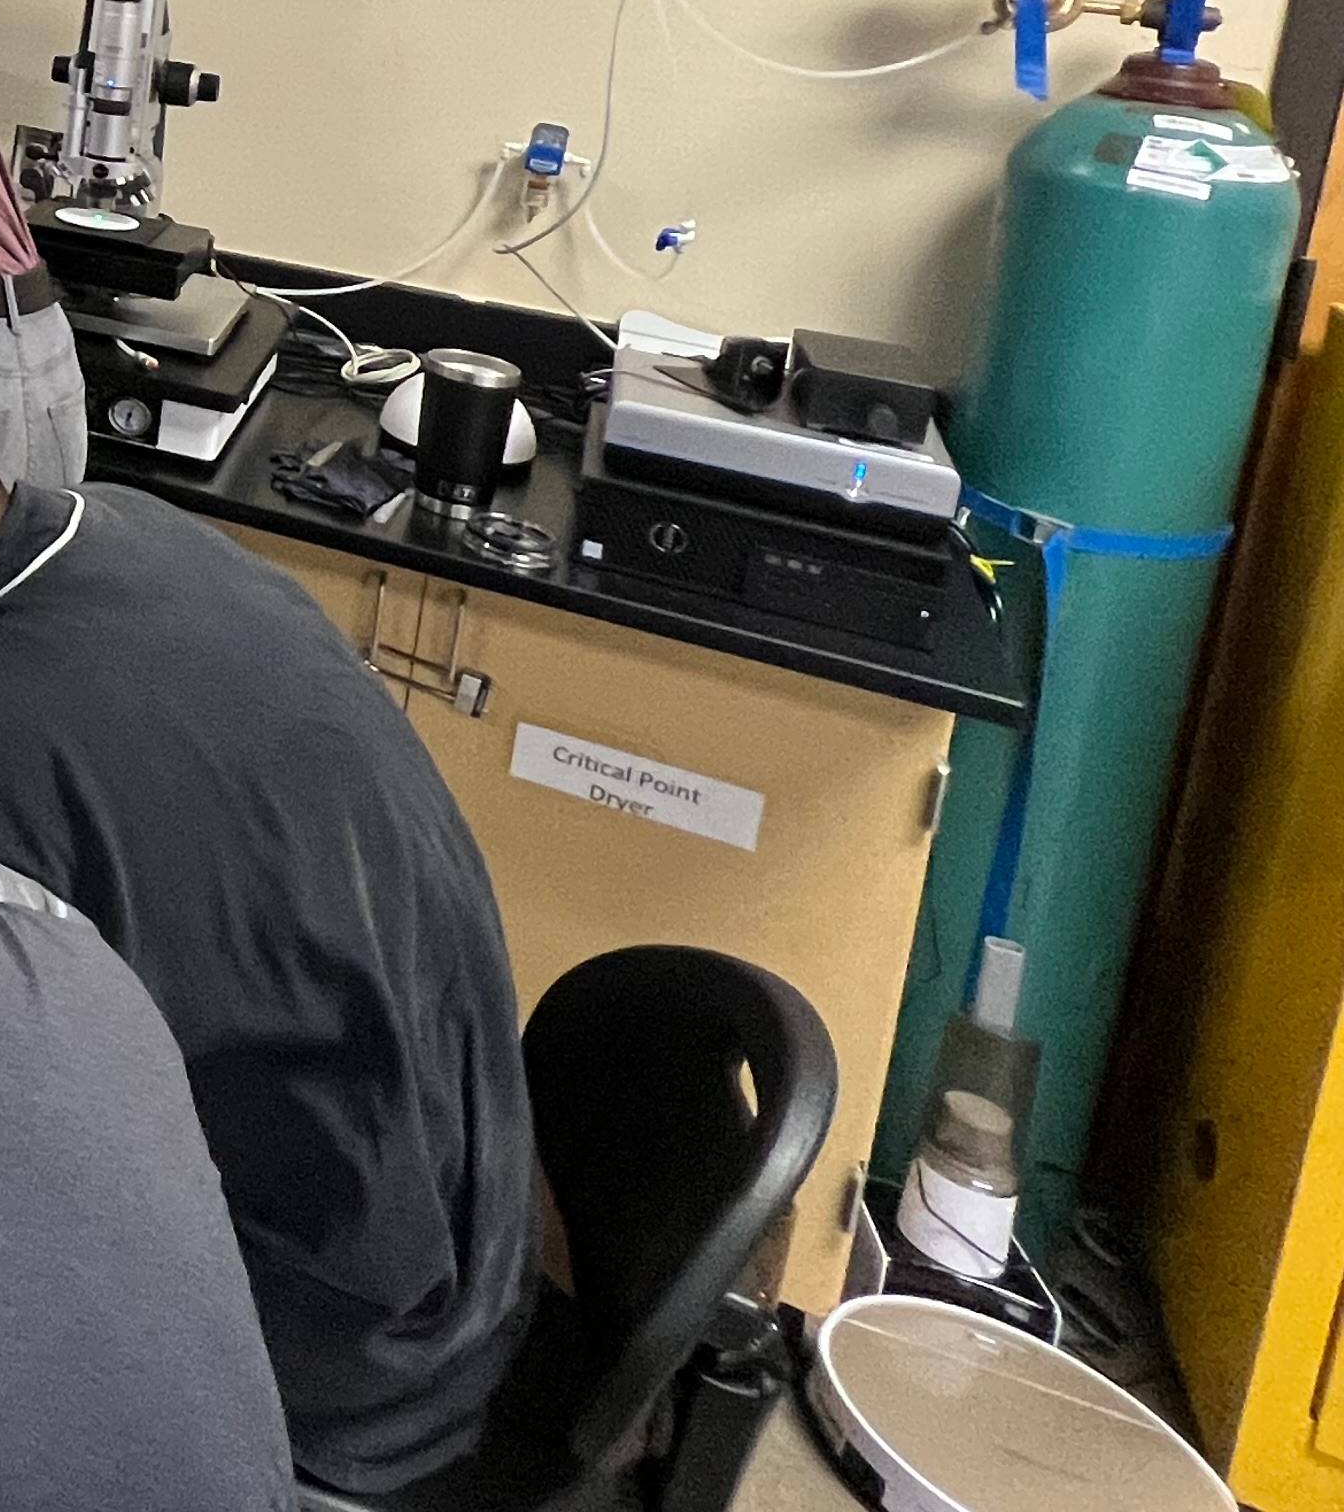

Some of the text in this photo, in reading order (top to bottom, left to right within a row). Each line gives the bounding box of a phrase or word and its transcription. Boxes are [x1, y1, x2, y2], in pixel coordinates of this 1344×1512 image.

[553, 746, 701, 805] Critical Point
[589, 784, 654, 815] Dryer
